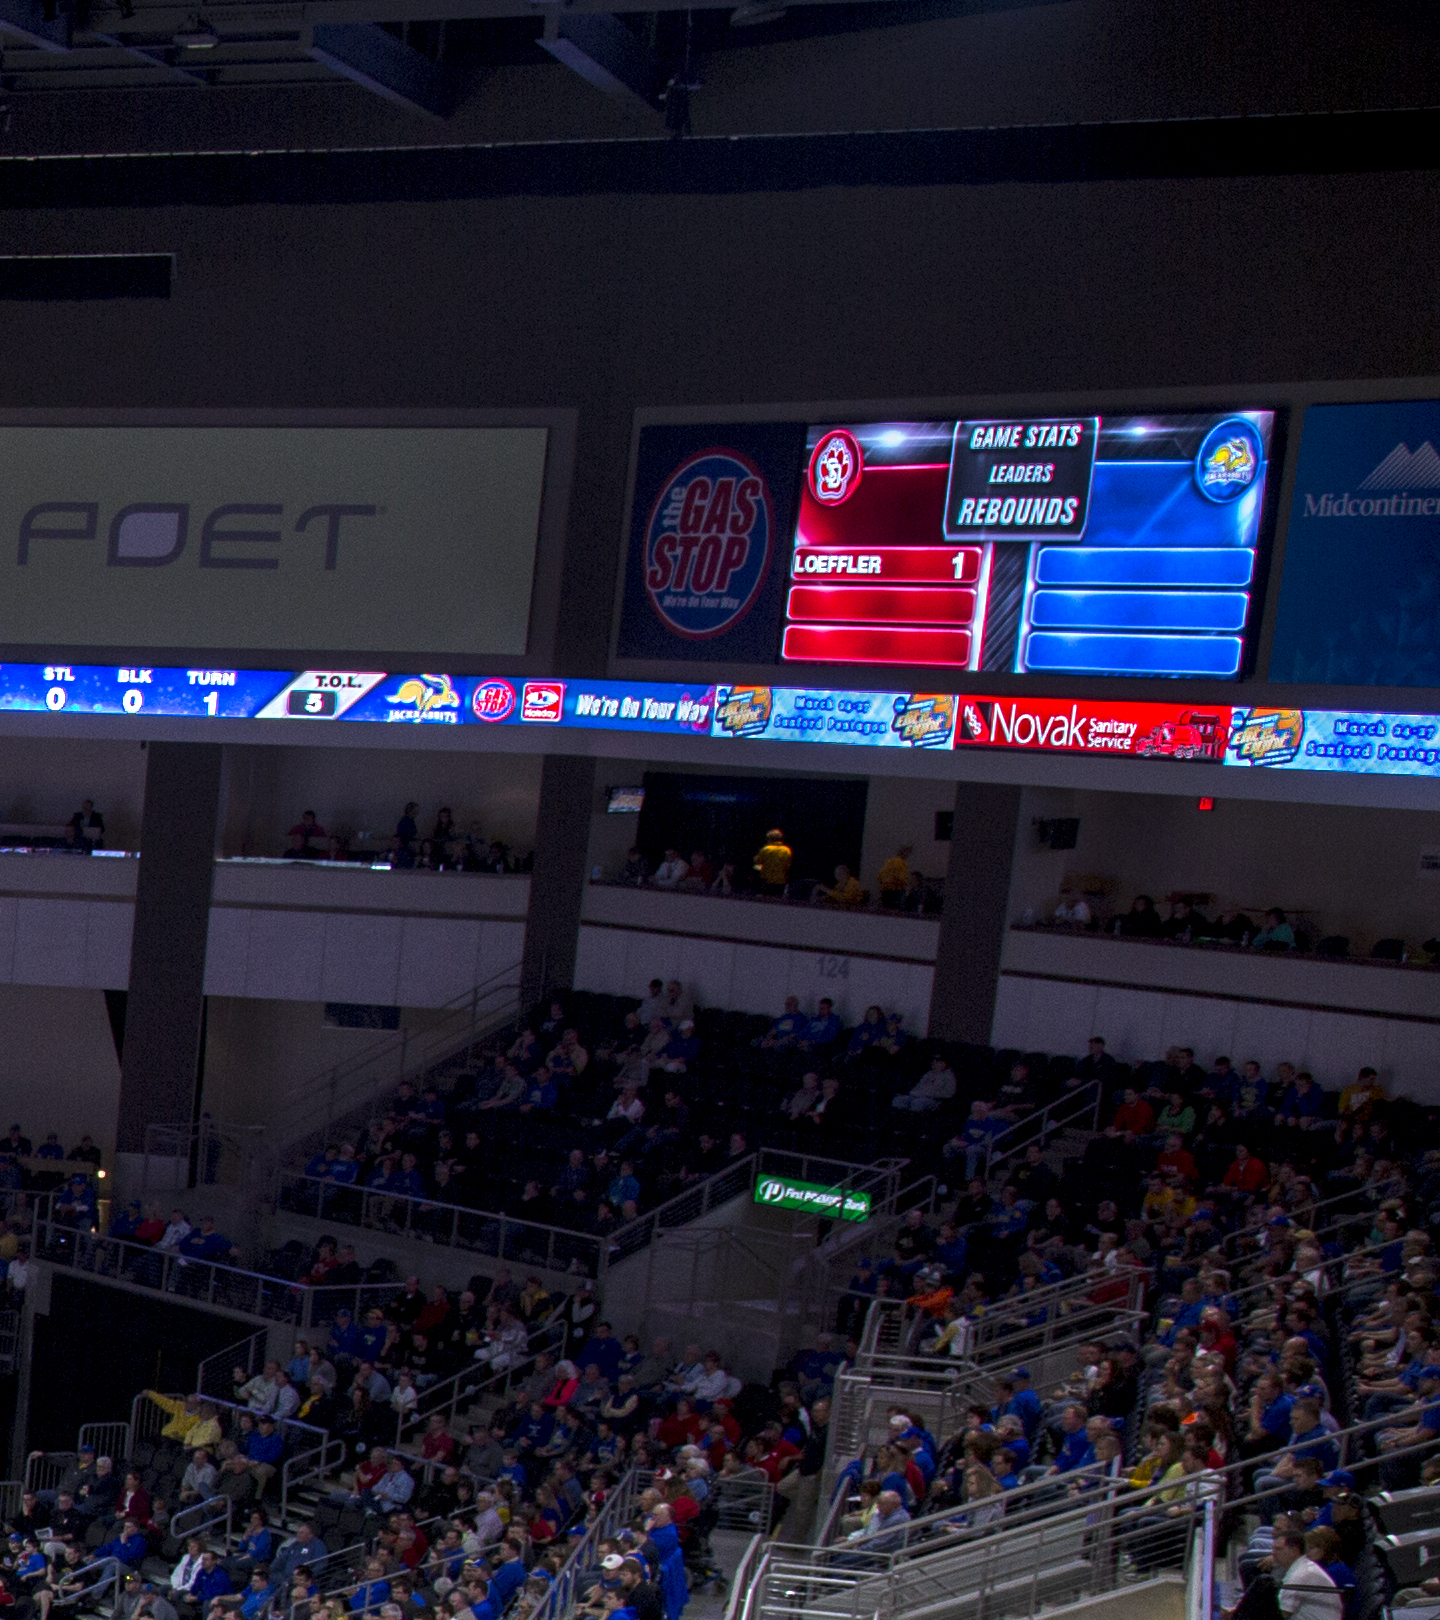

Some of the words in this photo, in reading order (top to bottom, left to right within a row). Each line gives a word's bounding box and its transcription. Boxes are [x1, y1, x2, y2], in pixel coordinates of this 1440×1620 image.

[970, 426, 1020, 450] GAME
[1025, 423, 1083, 448] STATS
[989, 463, 1054, 484] LEADERS
[680, 476, 764, 528] GAS
[957, 498, 1079, 526] REBOUNDS
[16, 501, 377, 571] POET
[647, 532, 751, 594] STOP
[794, 553, 882, 575] LOEFFLER
[43, 667, 75, 682] STL
[118, 670, 152, 684] BLK
[187, 671, 236, 686] TURN
[315, 675, 362, 689] T.O.L.
[46, 687, 66, 711] 0
[123, 688, 143, 714] 0
[203, 691, 219, 717] 1
[305, 692, 324, 712] 5
[576, 694, 618, 717] We're
[621, 697, 639, 719] On
[641, 699, 673, 722] Your
[674, 702, 709, 724] Way
[990, 703, 1086, 747] Novak
[1088, 717, 1138, 738] Sanitary
[1334, 719, 1387, 737] March
[1391, 724, 1437, 740] 24-27
[1087, 732, 1132, 750] Service
[1305, 740, 1373, 758] Sanford
[816, 957, 850, 980] 124
